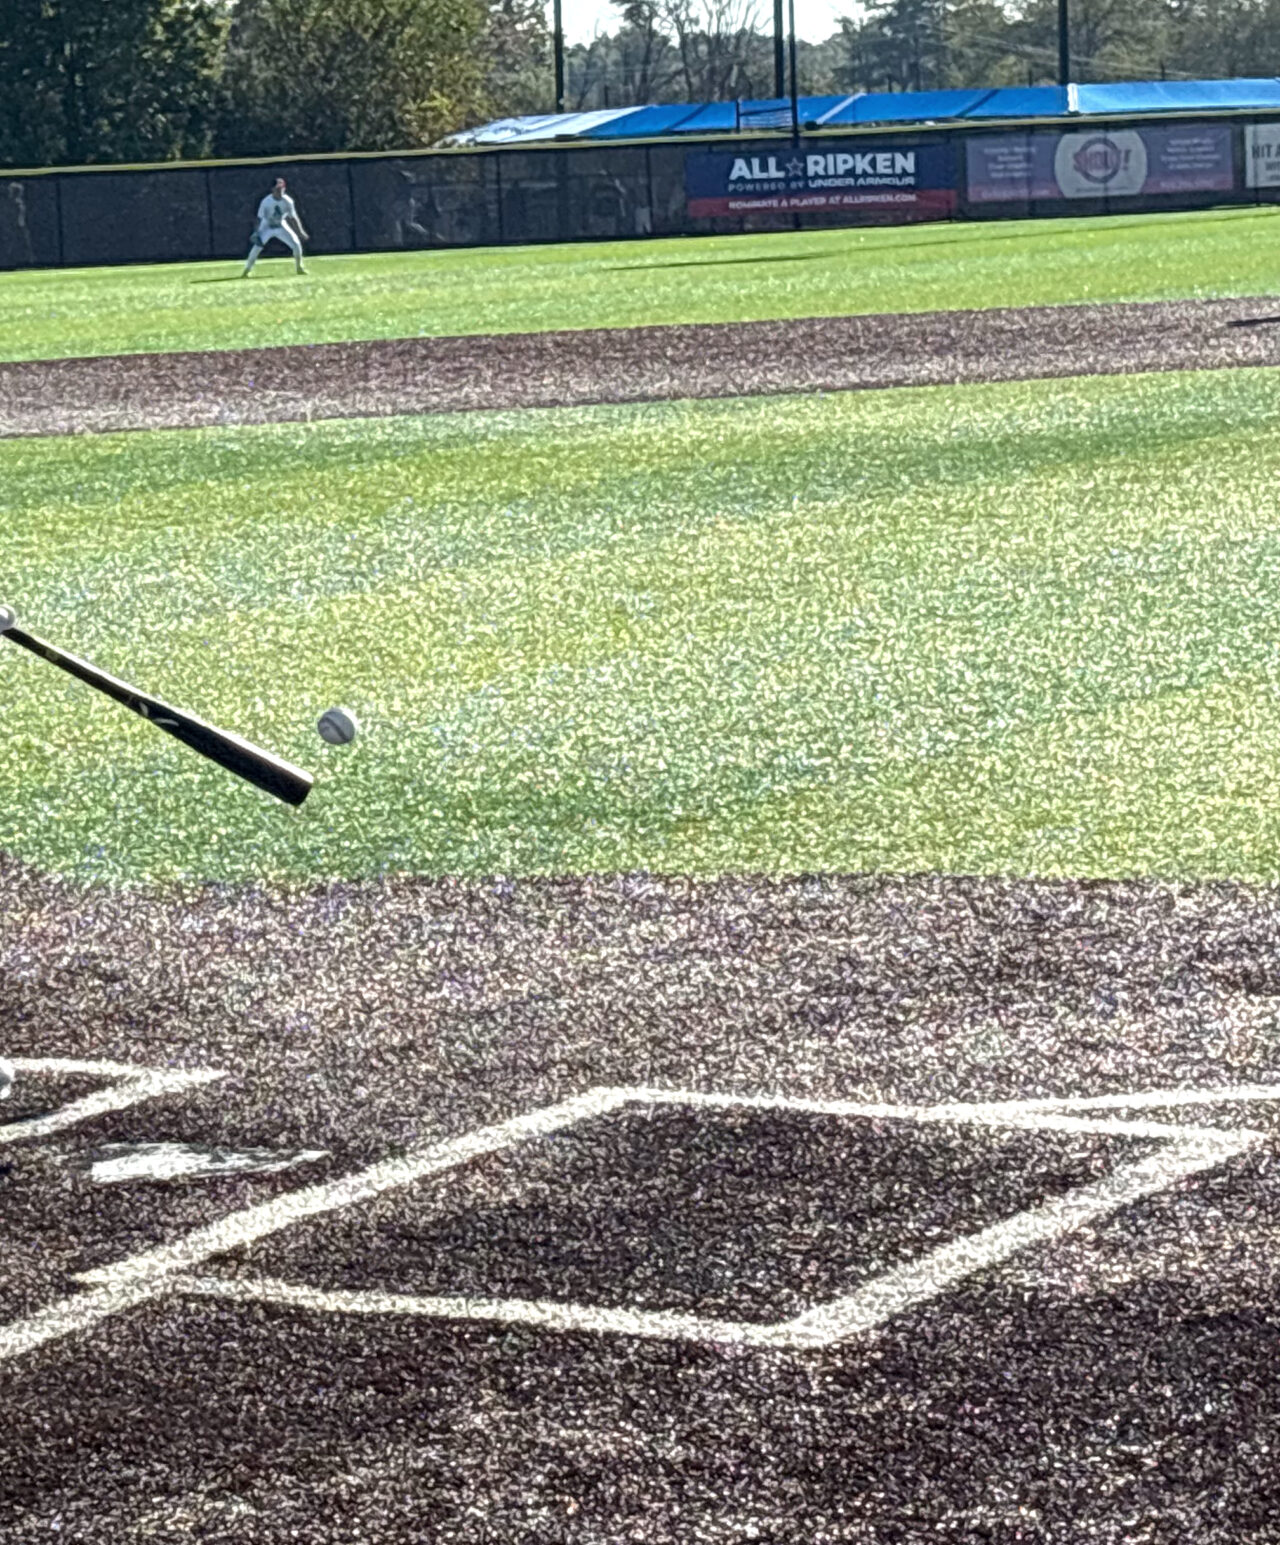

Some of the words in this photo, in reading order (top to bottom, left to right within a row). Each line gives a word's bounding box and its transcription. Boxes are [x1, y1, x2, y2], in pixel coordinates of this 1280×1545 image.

[729, 157, 786, 181] ALL
[806, 152, 916, 177] RIPKEN
[808, 178, 855, 189] UNDER
[856, 176, 916, 188] ARMOUR
[828, 195, 841, 205] AT
